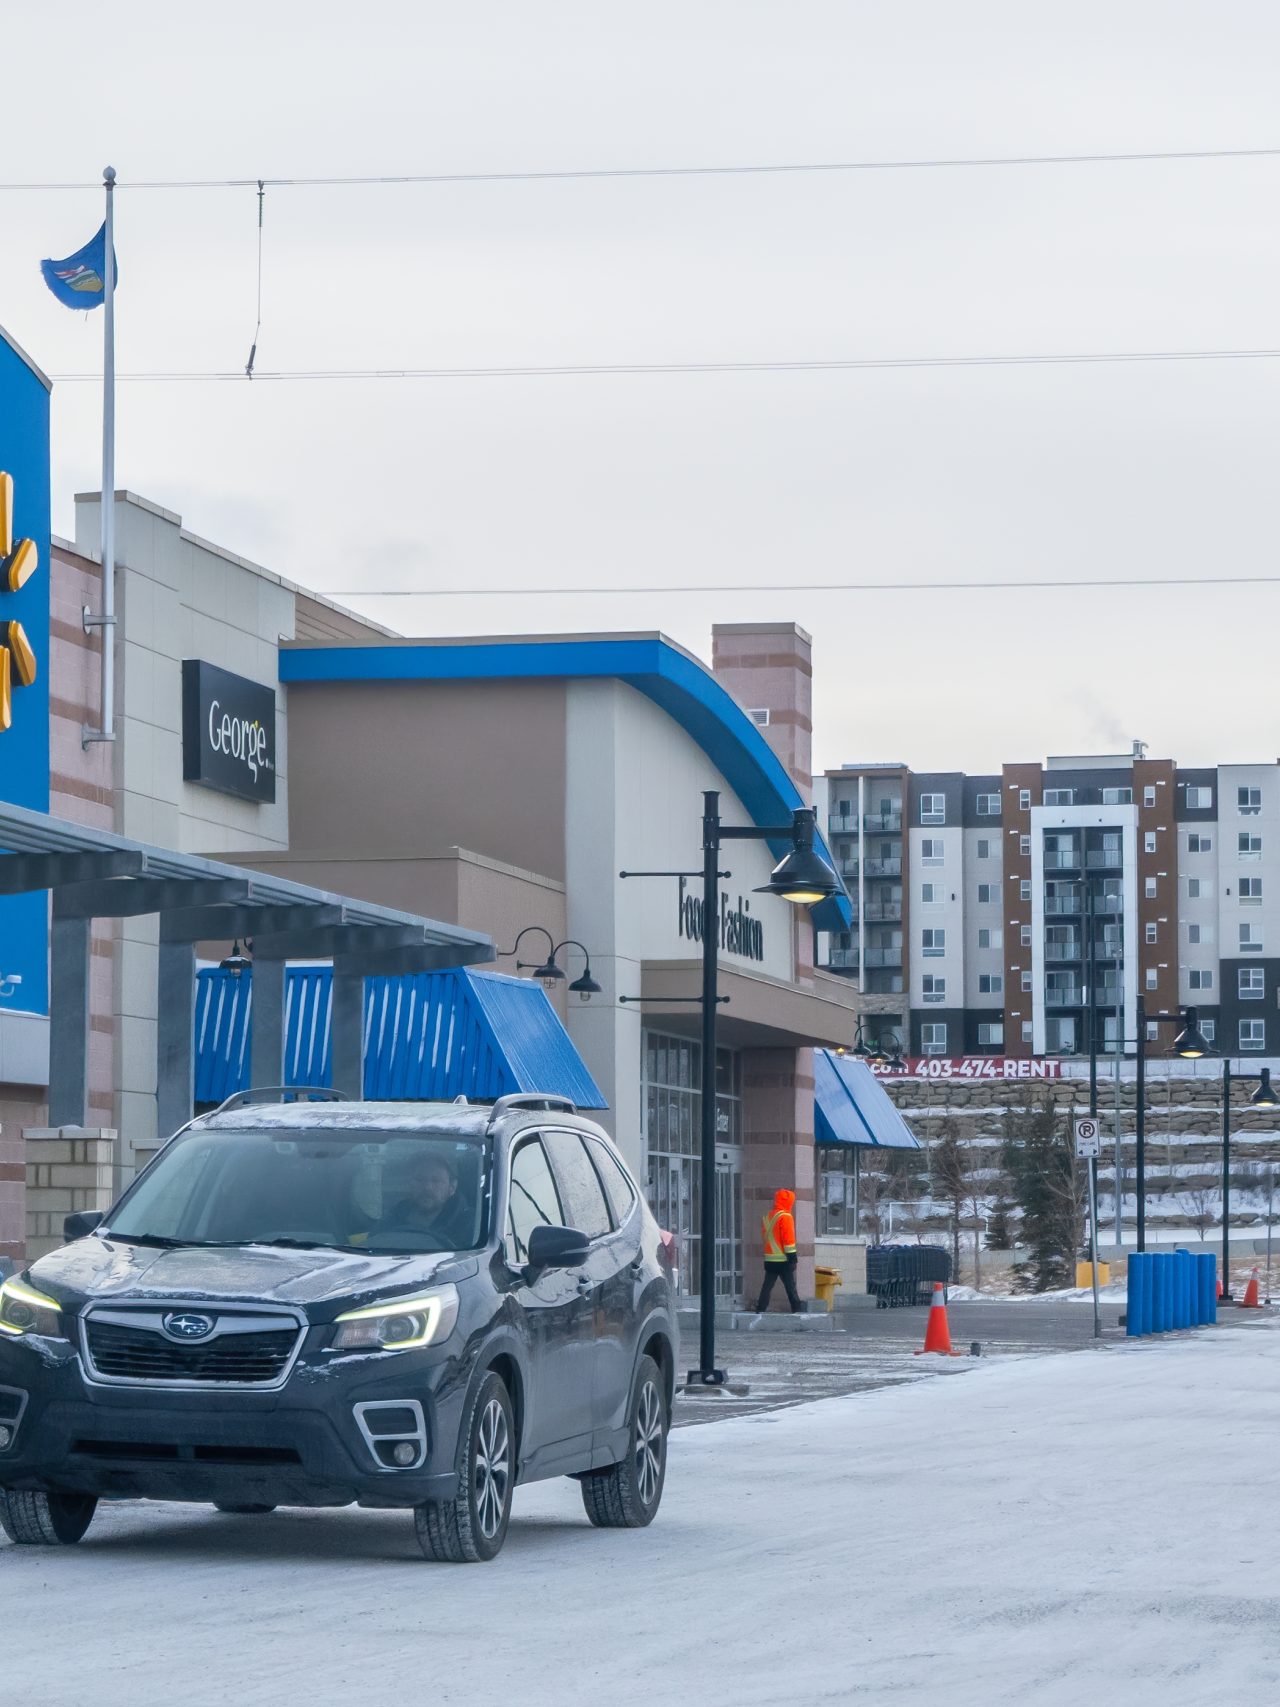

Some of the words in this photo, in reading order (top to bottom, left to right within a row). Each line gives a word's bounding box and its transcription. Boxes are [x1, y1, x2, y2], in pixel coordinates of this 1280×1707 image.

[679, 876, 704, 943] Foo
[721, 892, 763, 961] Fashion
[915, 1060, 1059, 1077] 403-474-RENT
